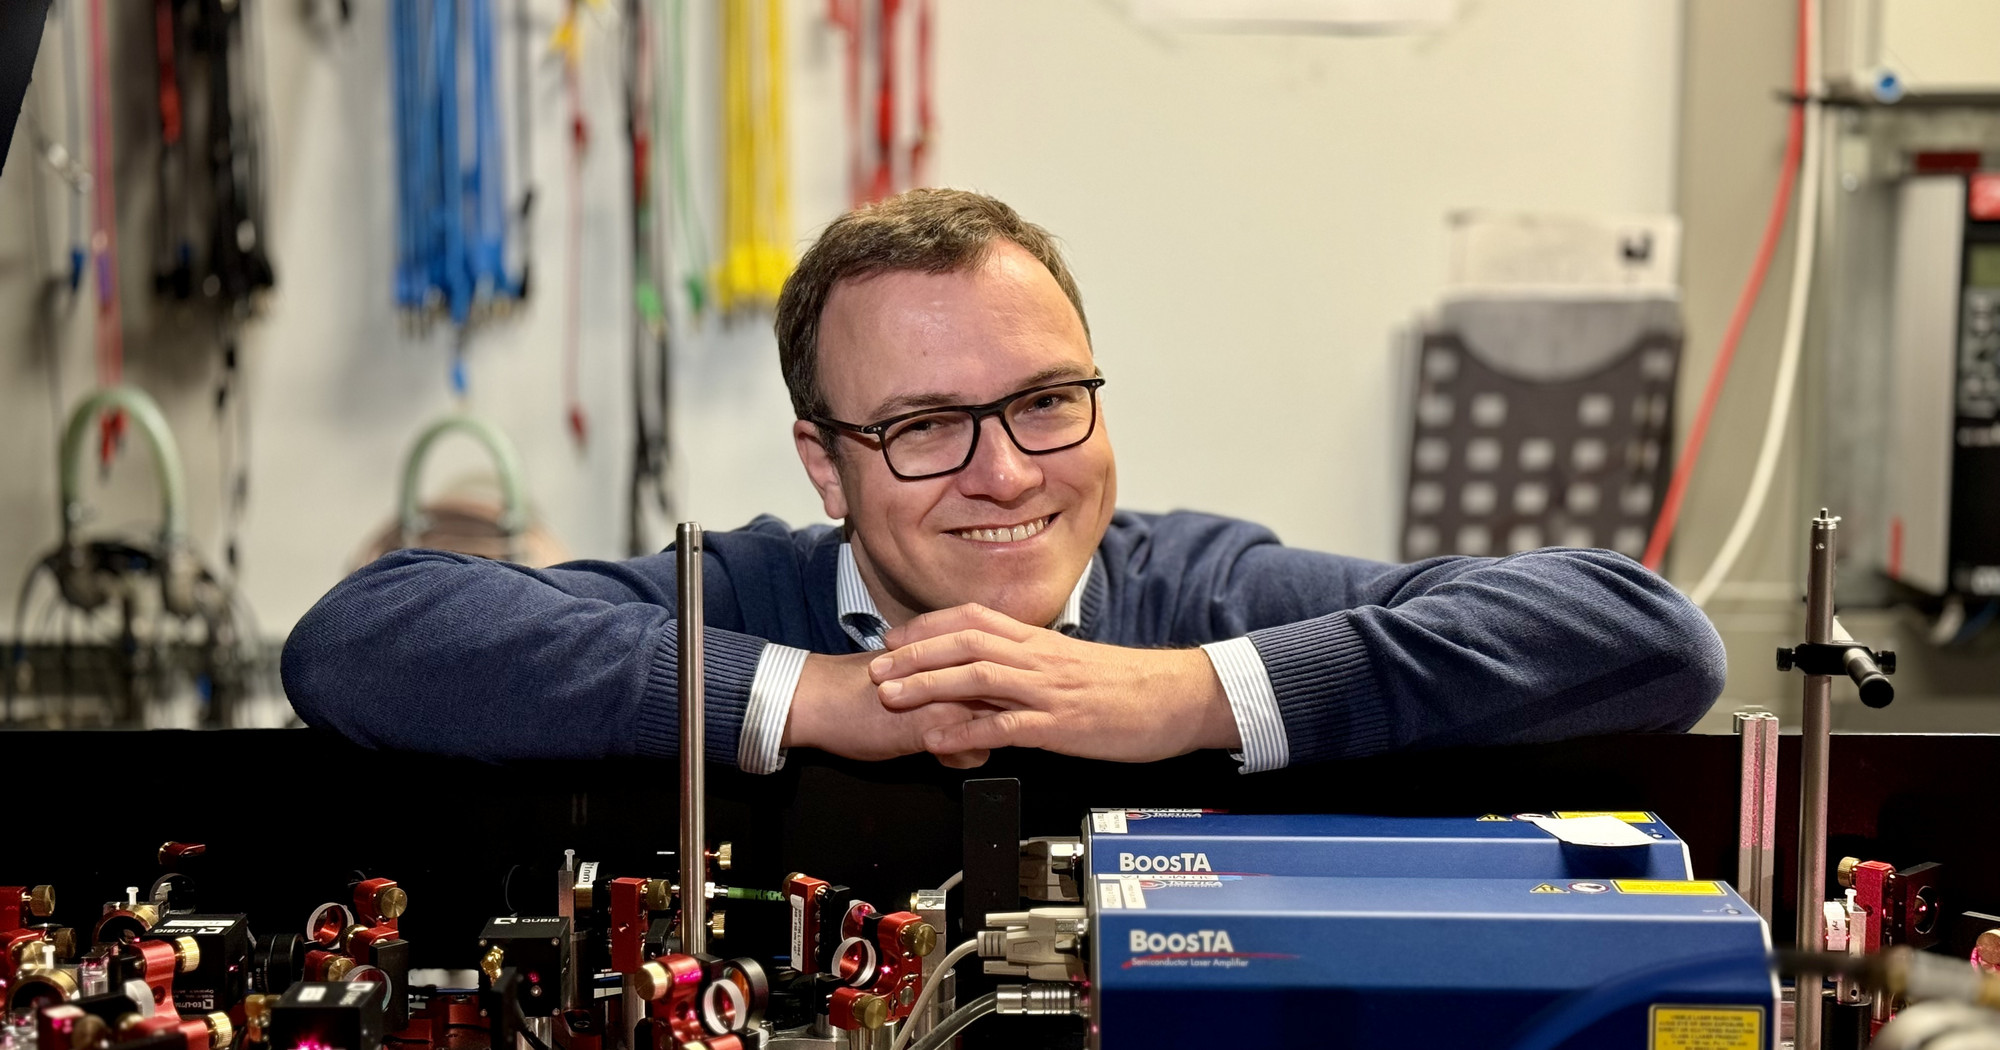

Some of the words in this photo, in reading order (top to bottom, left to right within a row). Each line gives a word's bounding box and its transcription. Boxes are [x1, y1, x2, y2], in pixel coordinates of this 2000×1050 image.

[1131, 957, 1189, 967] Semiconductor
[1190, 958, 1211, 967] Laser
[1212, 958, 1249, 969] Amplifier
